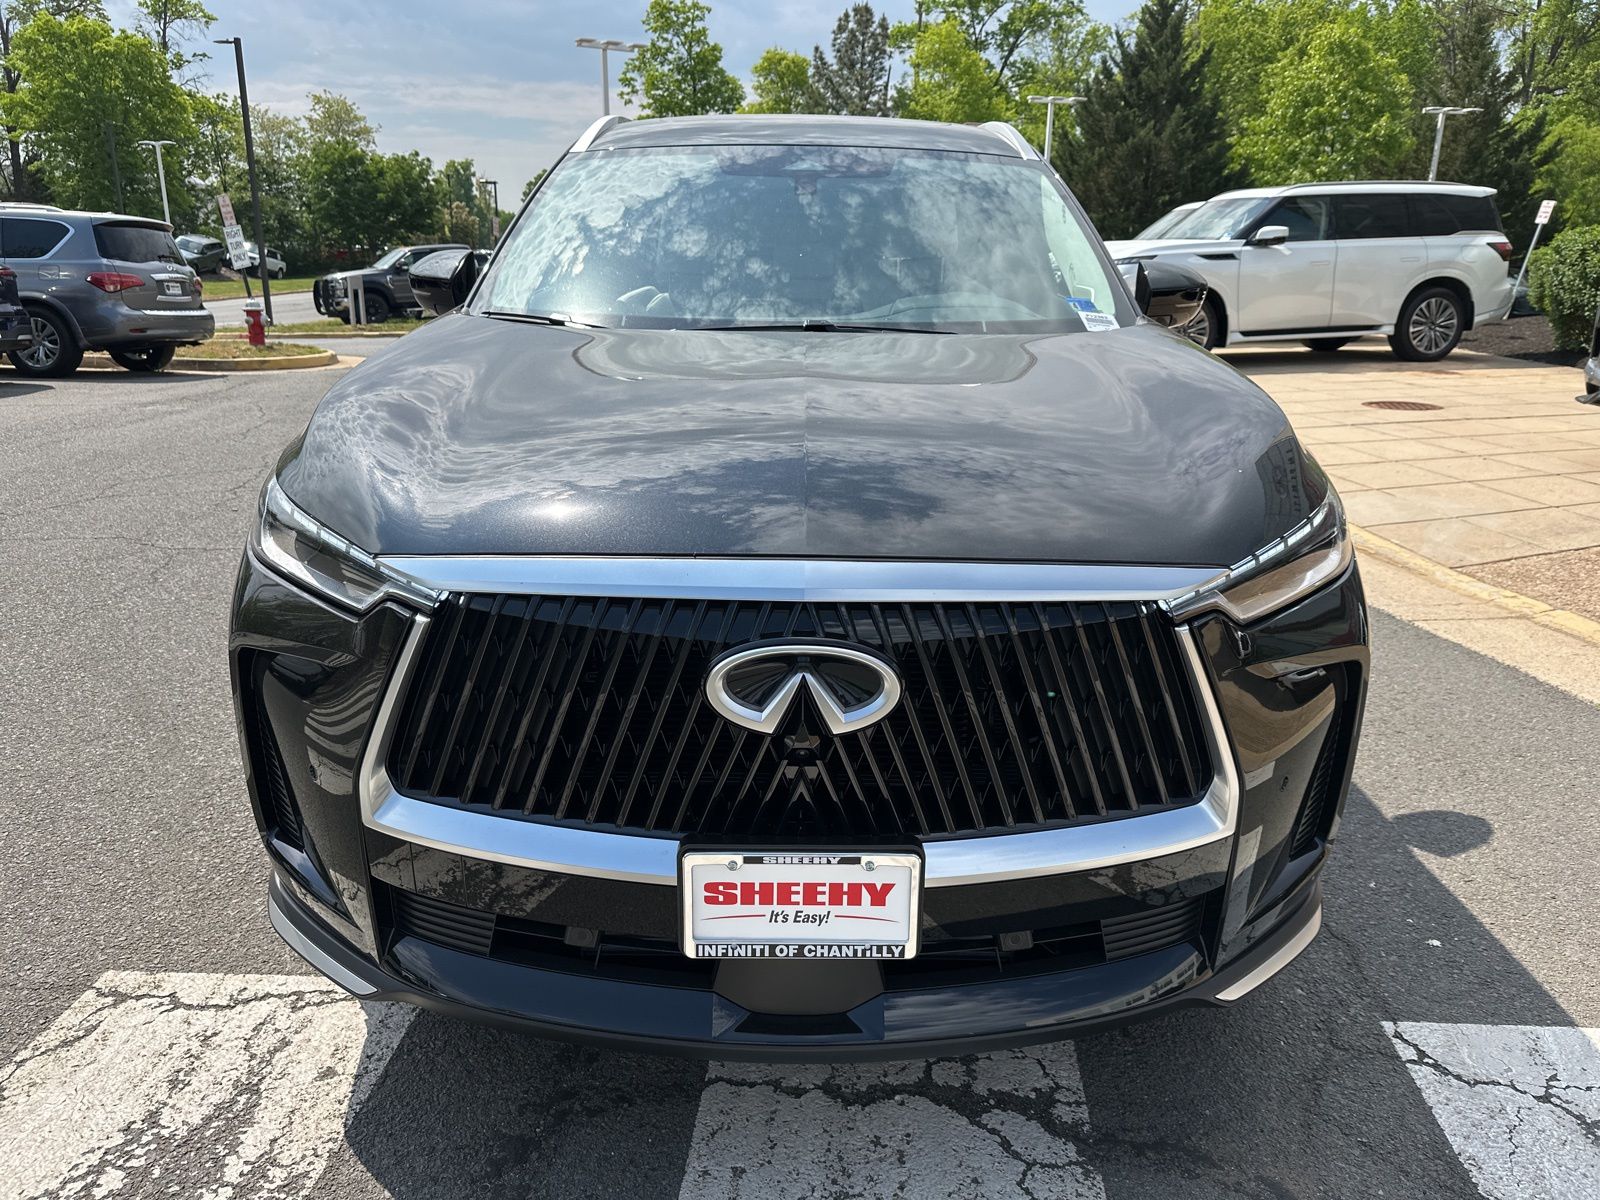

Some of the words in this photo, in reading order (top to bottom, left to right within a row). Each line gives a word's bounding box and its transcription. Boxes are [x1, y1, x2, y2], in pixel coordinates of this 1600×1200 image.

[225, 229, 242, 239] RIGHT
[229, 241, 244, 250] TURN
[233, 252, 246, 262] ONLY
[762, 856, 841, 864] SHEEHY
[703, 881, 896, 907] SHEEHY
[768, 910, 789, 924] It's
[793, 910, 831, 927] Easy!
[698, 944, 770, 957] INFINITI
[775, 944, 800, 957] OF
[803, 945, 904, 958] CHANTILLY
